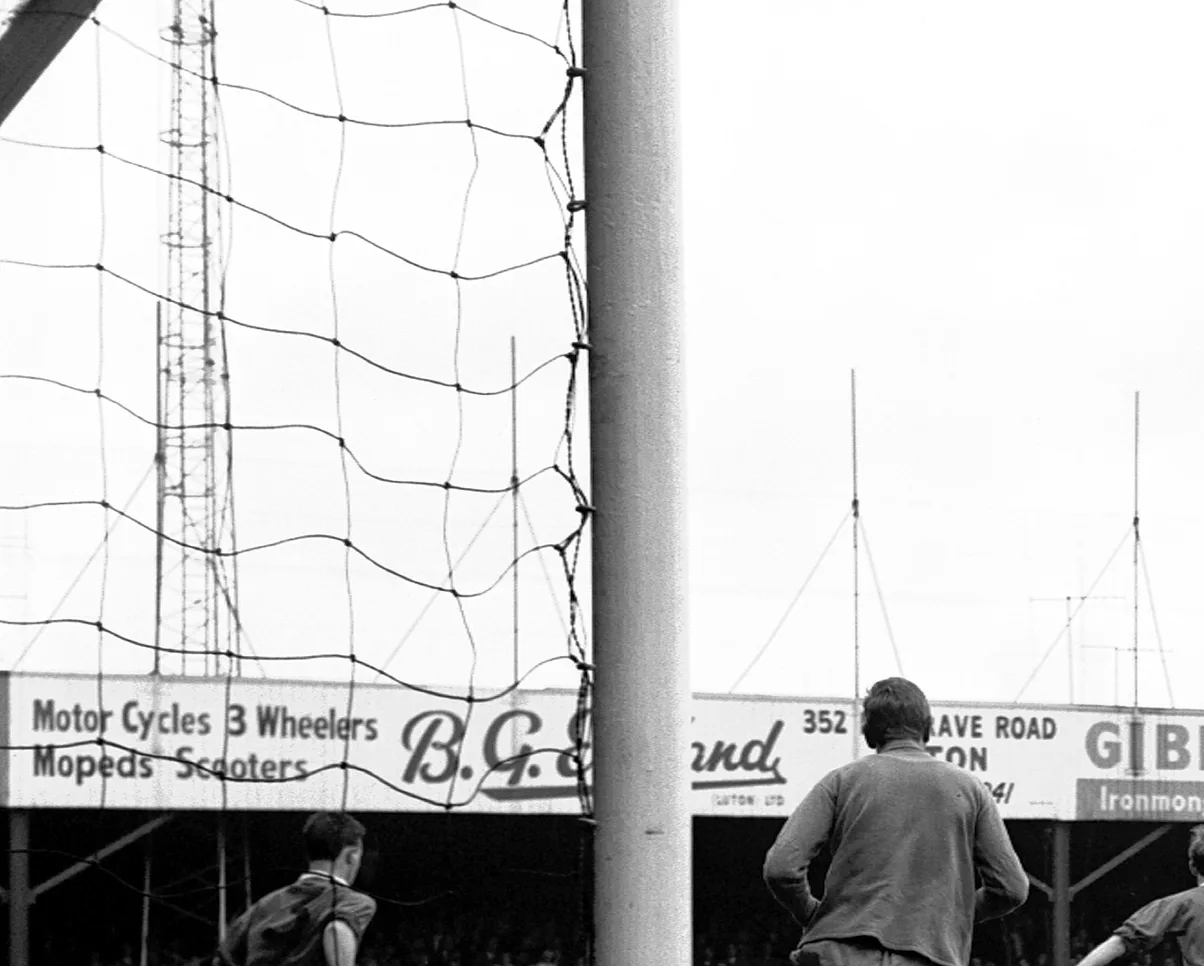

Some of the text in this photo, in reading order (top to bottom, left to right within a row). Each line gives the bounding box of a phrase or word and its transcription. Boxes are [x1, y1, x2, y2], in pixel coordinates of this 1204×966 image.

[34, 699, 378, 741] Motor Cycles 3 Wheelers
[803, 709, 847, 734] 352
[995, 715, 1057, 740] ROAD
[33, 745, 308, 785] Mopeds Scooters
